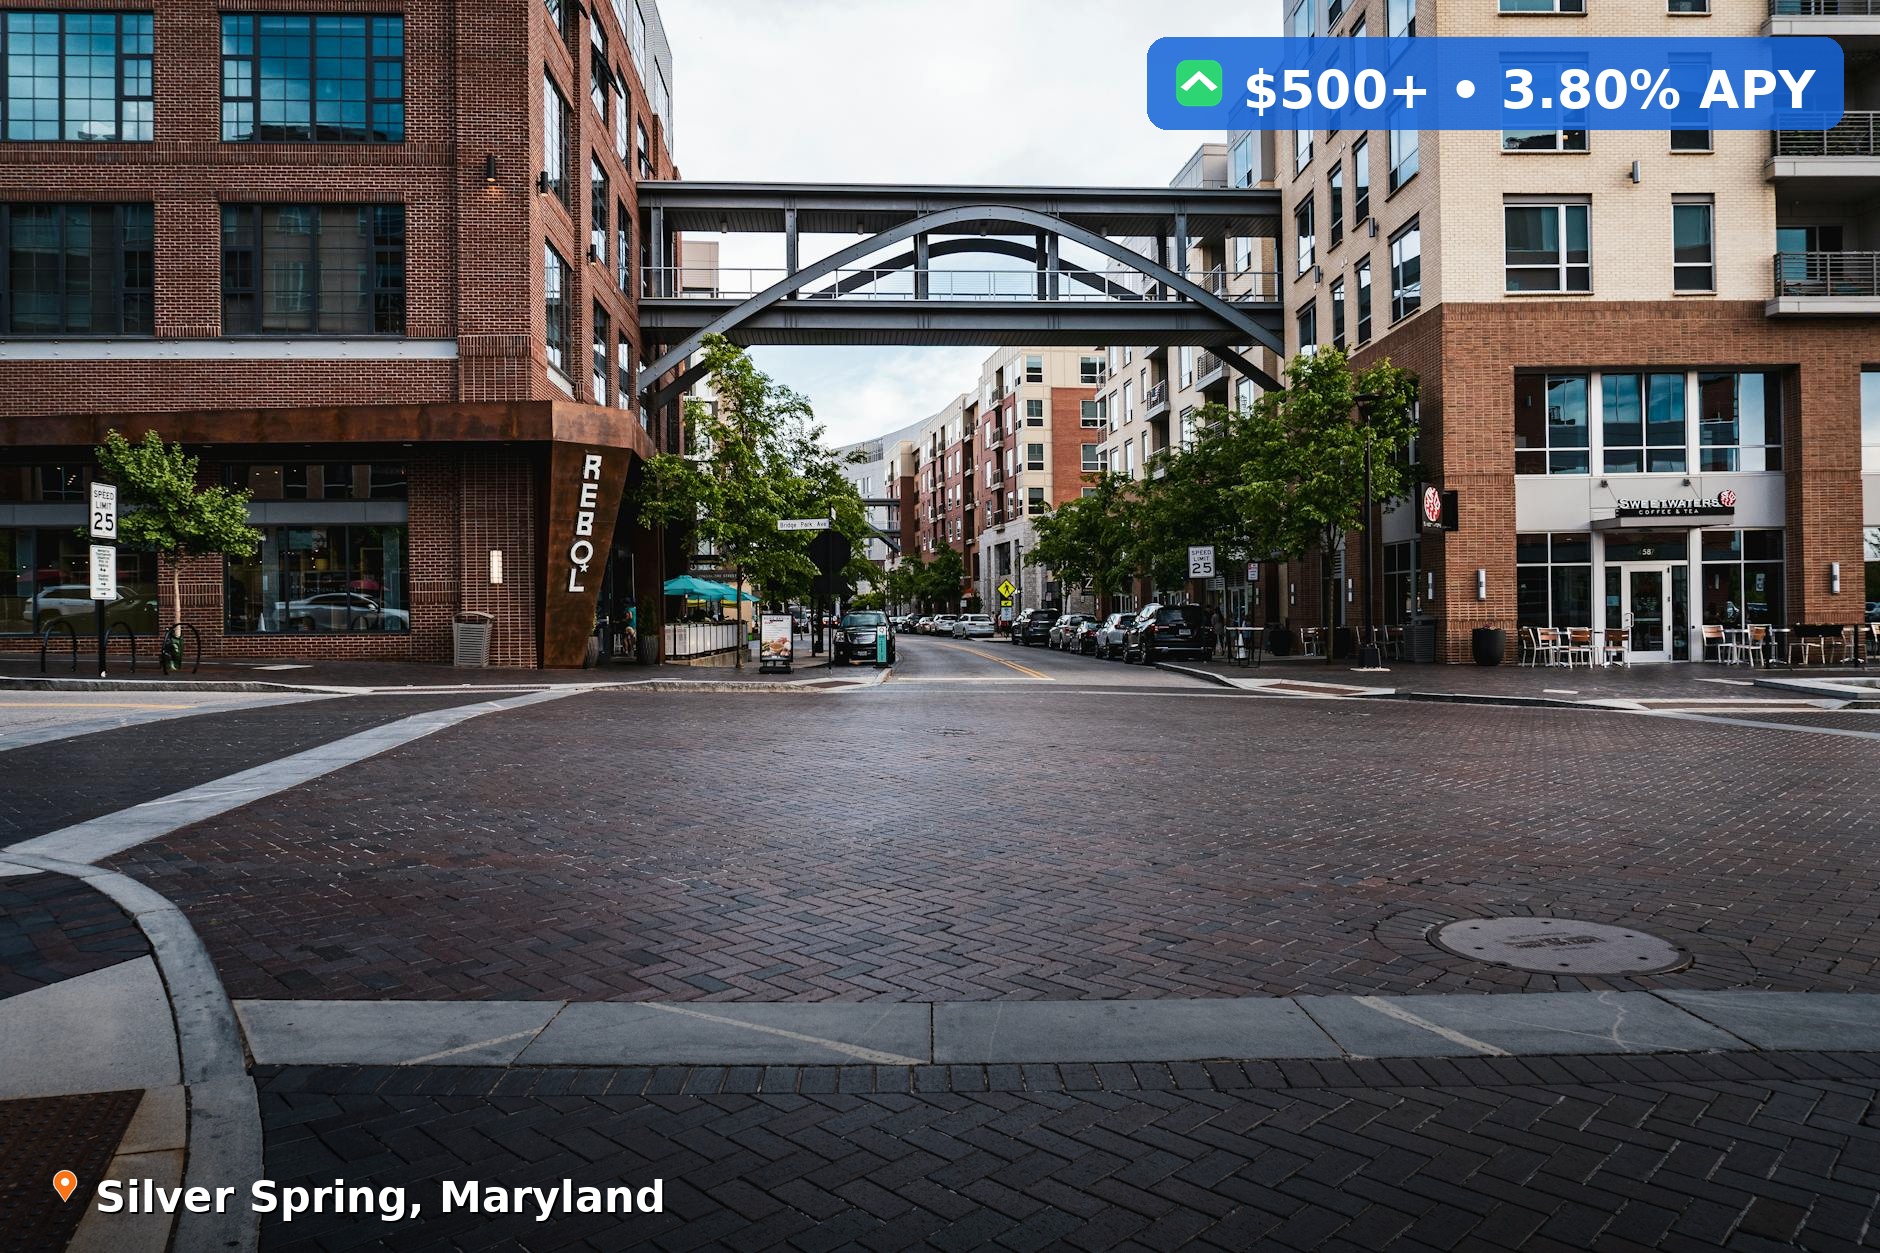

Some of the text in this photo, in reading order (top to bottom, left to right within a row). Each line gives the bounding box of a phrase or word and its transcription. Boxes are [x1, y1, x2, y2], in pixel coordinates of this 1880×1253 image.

[94, 490, 114, 500] SPEED
[95, 501, 111, 510] LIMIT
[94, 512, 113, 531] 25
[568, 454, 602, 592] REBOL
[1192, 562, 1212, 574] 25
